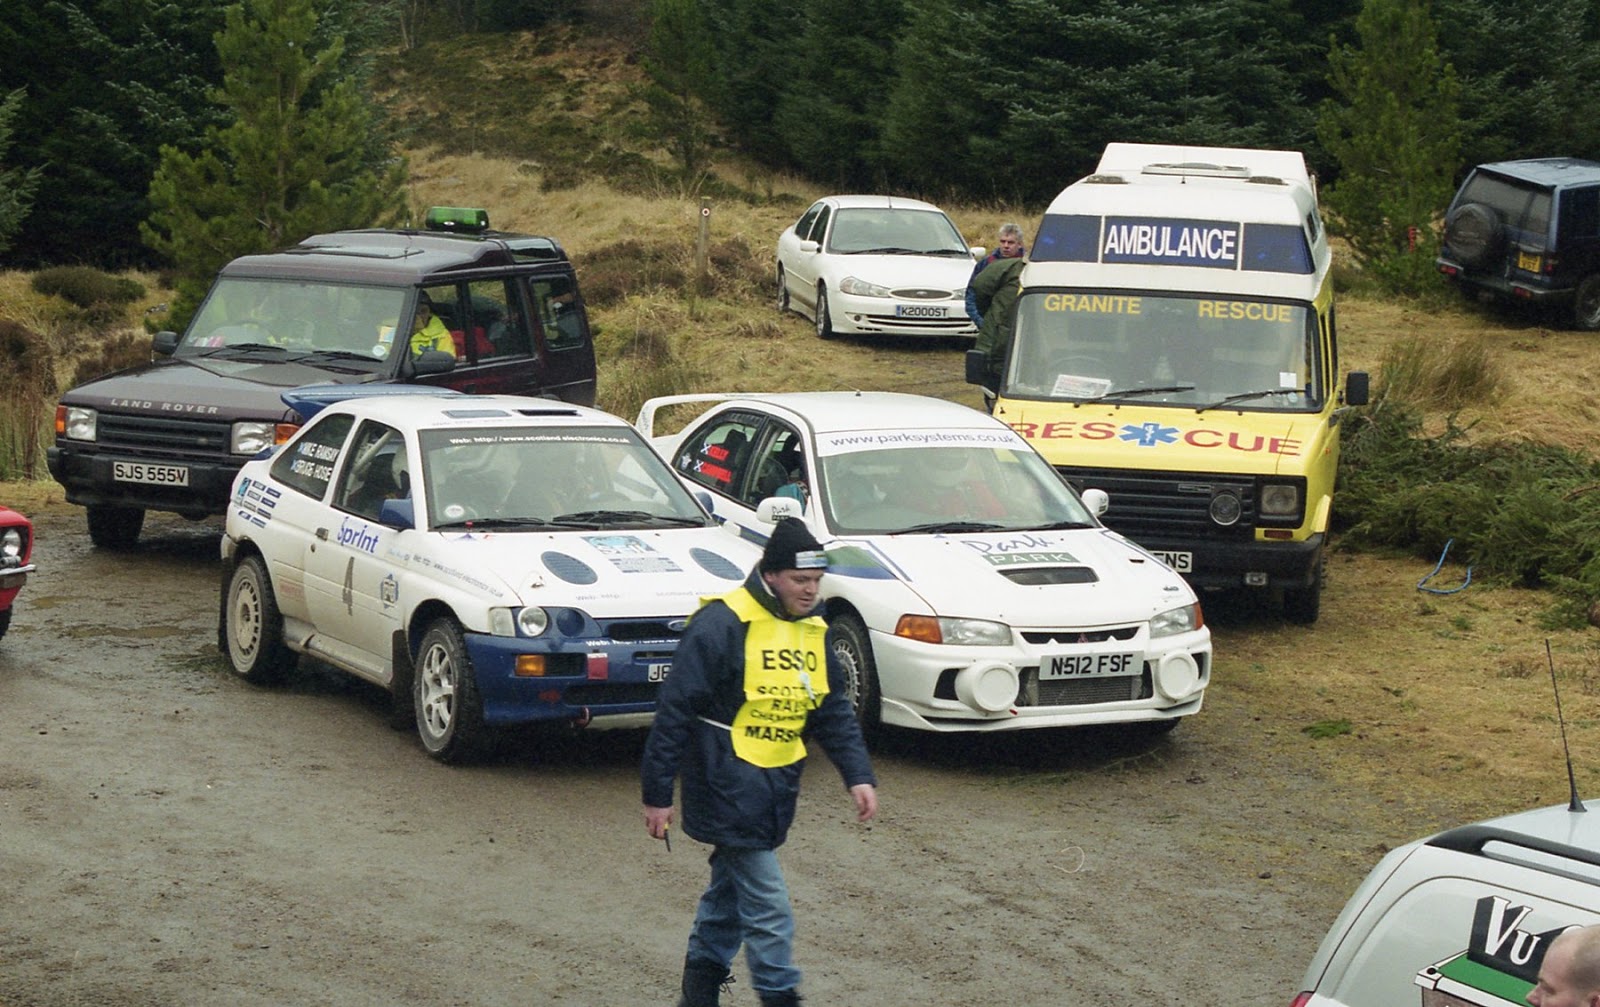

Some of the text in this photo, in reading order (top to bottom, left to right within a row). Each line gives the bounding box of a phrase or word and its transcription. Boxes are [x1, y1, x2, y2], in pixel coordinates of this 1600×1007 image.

[1104, 224, 1237, 260] AMBULANCE
[1043, 293, 1293, 323] GRANITE RESCUE
[110, 398, 220, 415] LAND ROVER
[830, 431, 1017, 447] www.parksystems.co.uk
[115, 463, 187, 483] SJS 555V
[337, 515, 379, 553] Sprint
[990, 552, 1073, 564] PARK
[762, 648, 817, 672] ESSO
[1050, 653, 1134, 676] N512 FSF
